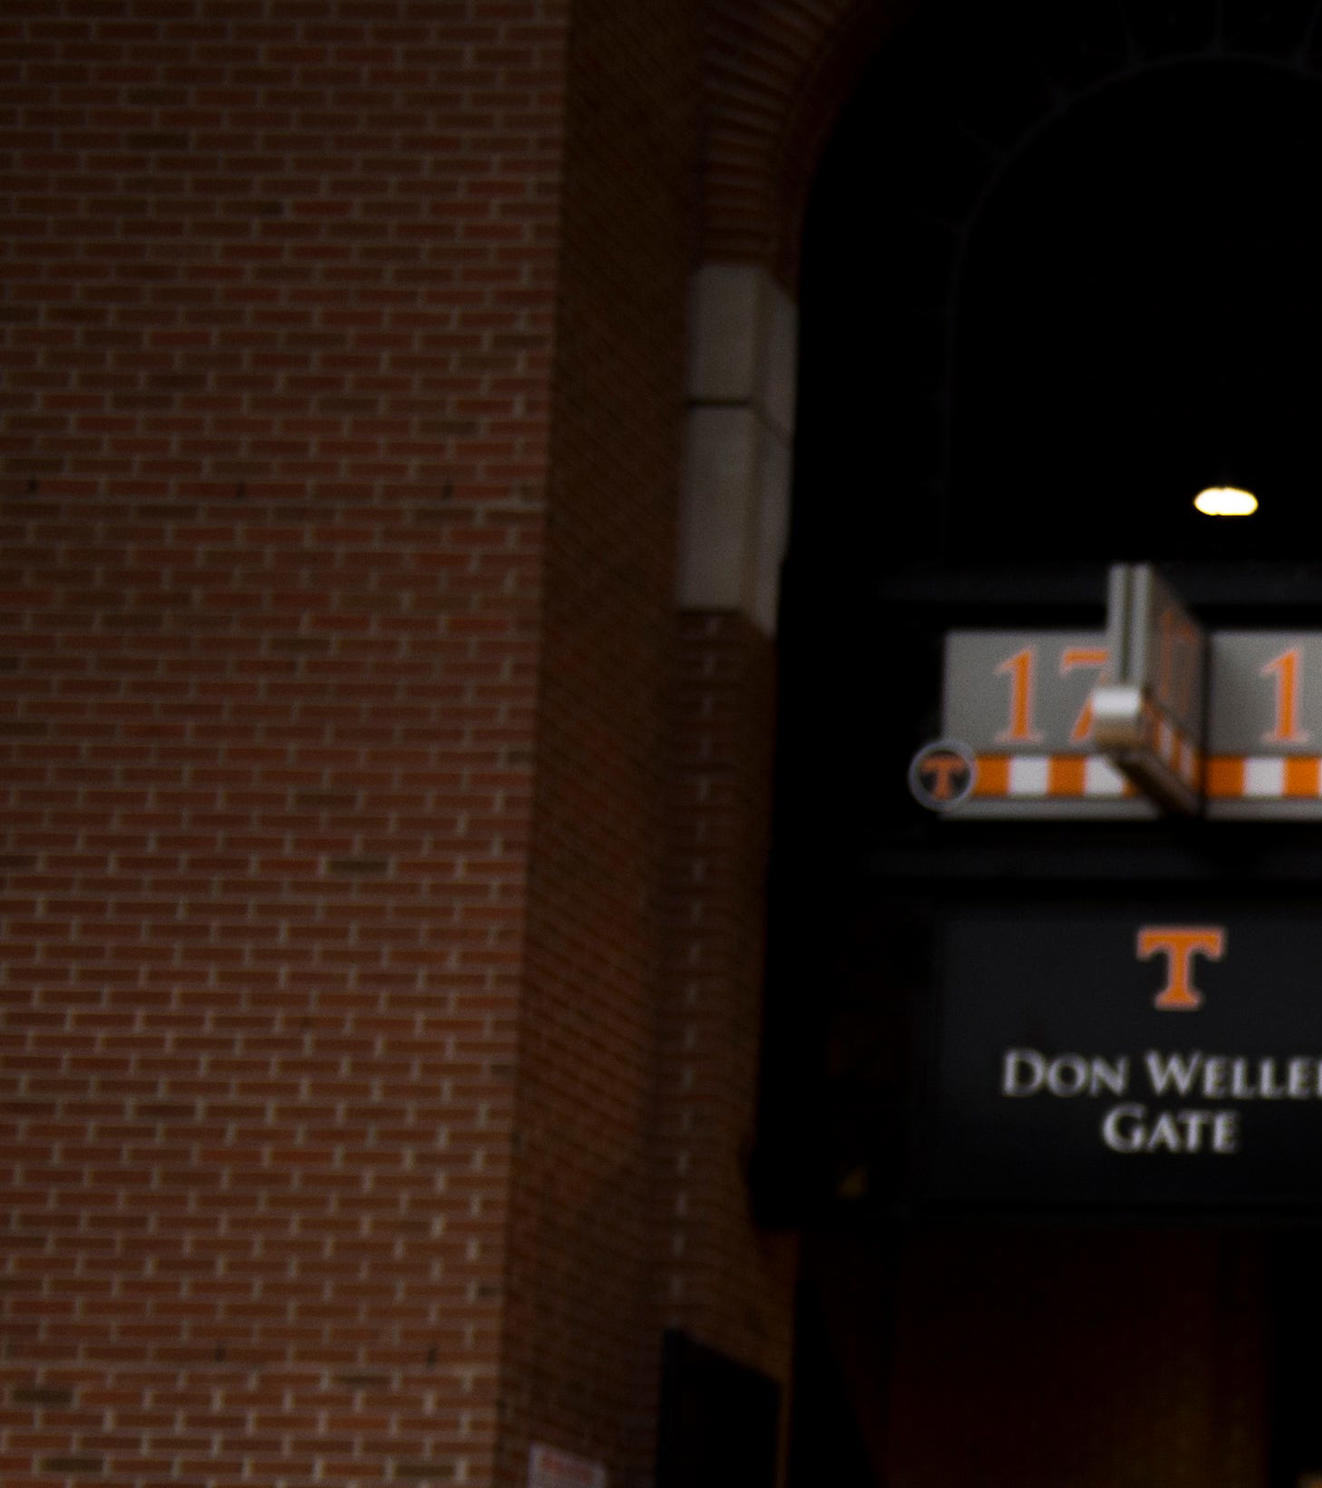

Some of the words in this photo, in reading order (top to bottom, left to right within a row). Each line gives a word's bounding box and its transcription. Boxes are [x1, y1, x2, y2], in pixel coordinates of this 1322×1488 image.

[1136, 925, 1226, 1011] T
[1001, 1049, 1129, 1099] DON
[1101, 1102, 1241, 1154] GATE
